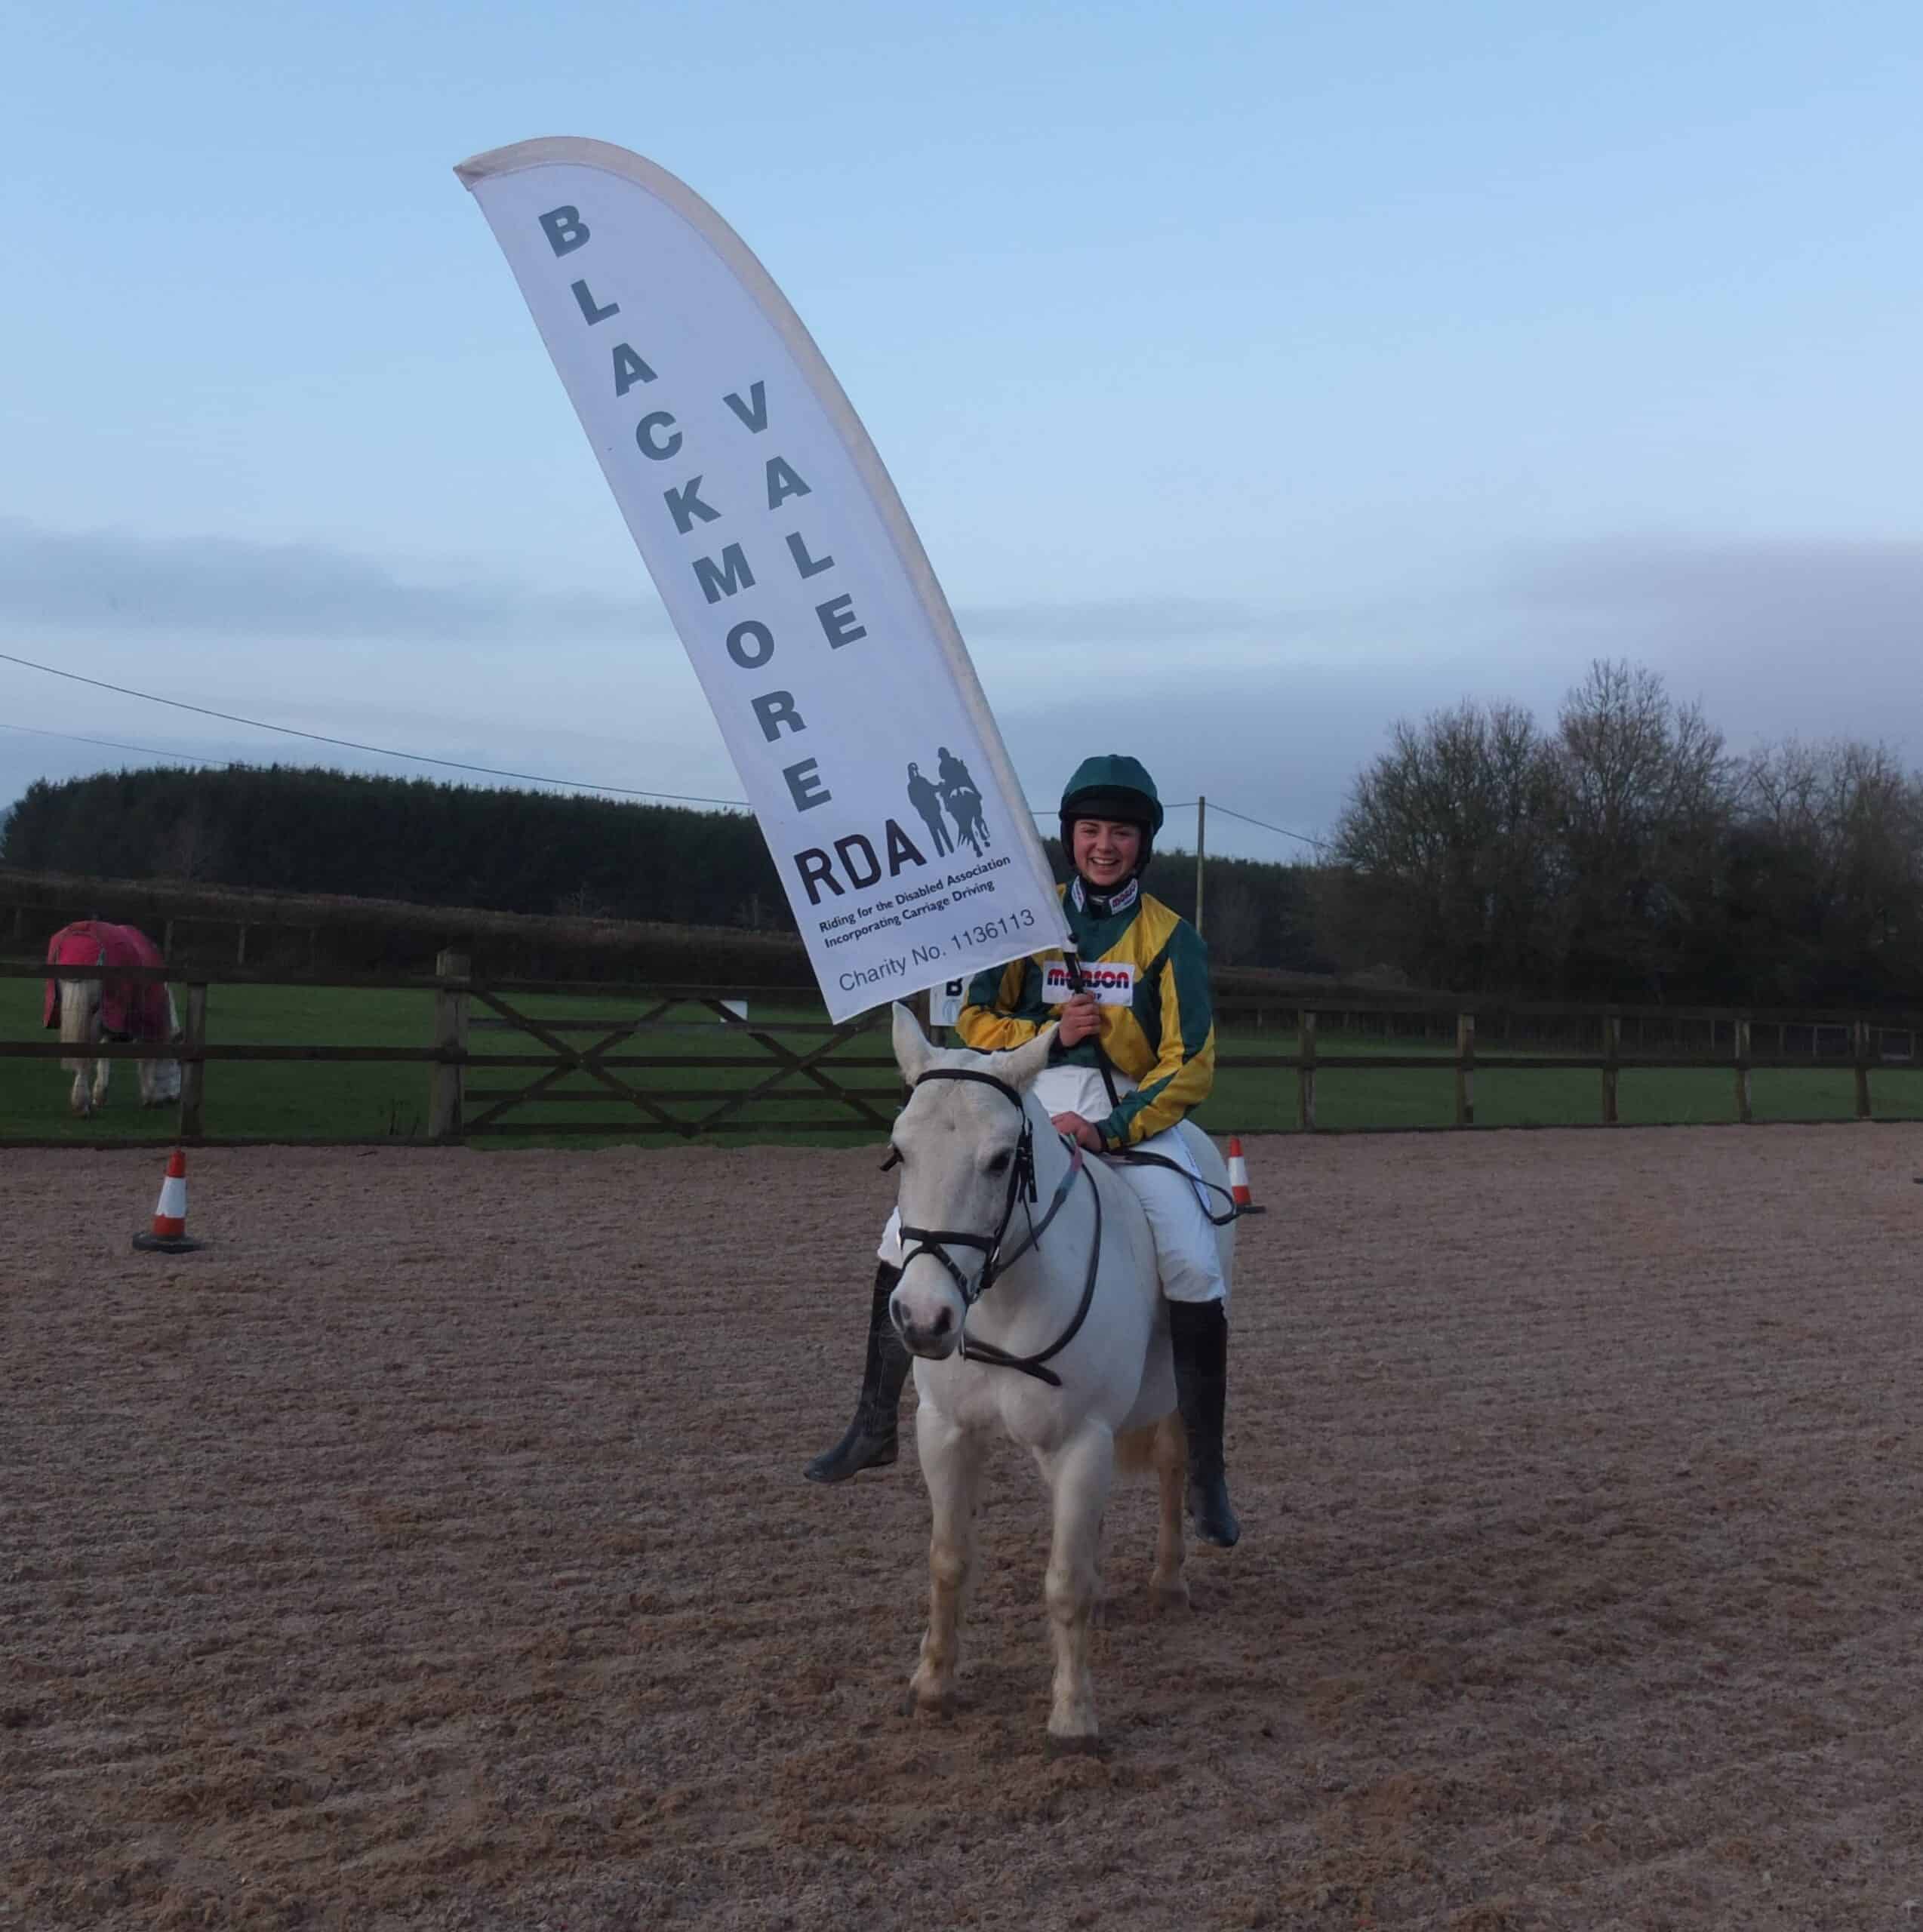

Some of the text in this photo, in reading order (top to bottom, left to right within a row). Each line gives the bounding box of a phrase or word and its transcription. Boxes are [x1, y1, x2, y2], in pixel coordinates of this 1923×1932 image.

[538, 205, 832, 813] BLACKMORE
[722, 380, 867, 650] VALE
[793, 819, 928, 906] RDA
[818, 857, 1011, 933] Riding for the Disabled Association
[824, 880, 995, 948] Incorporating Carriage Driving
[839, 909, 1035, 992] Charity No. 1136113
[1047, 968, 1129, 989] mson
